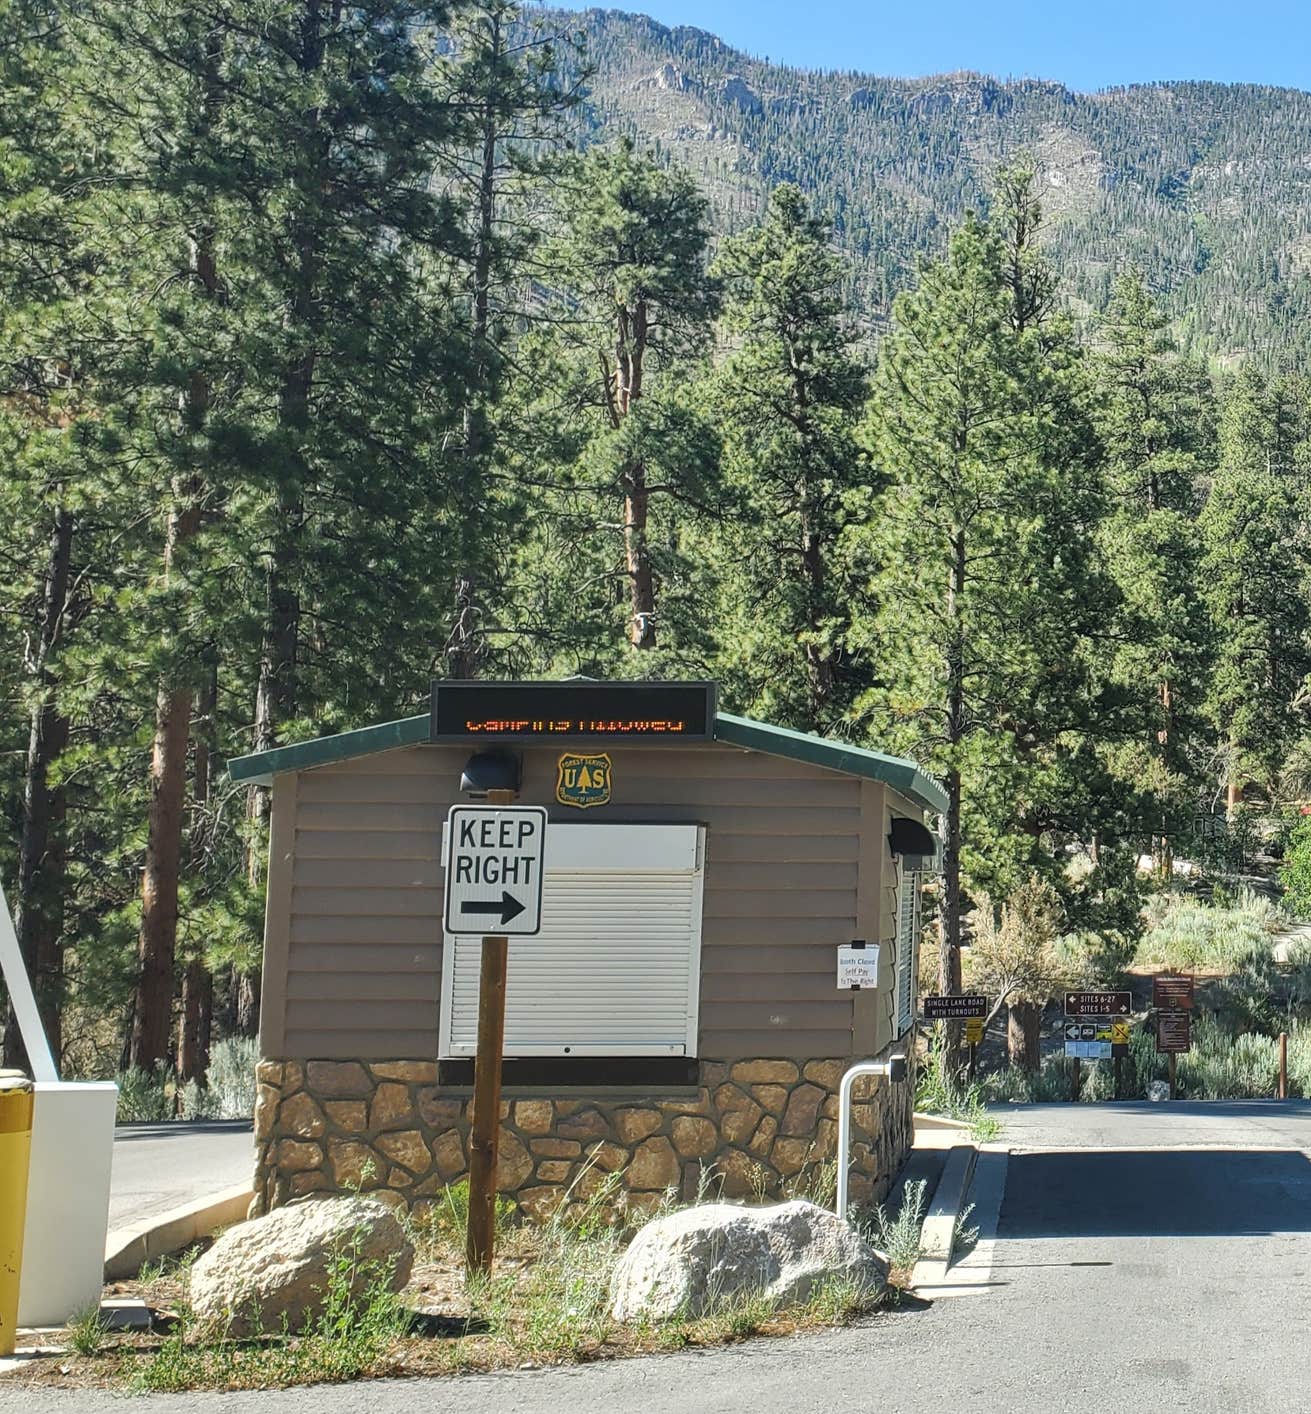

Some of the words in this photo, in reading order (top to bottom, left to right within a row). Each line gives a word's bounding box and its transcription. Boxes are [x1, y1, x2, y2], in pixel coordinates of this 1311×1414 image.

[564, 768, 576, 788] U
[593, 769, 605, 788] S
[460, 819, 535, 848] KEEP
[455, 855, 536, 885] RIGHT
[927, 999, 949, 1007] SINGLE
[968, 998, 985, 1006] ROAD
[1080, 995, 1099, 1003] SITES
[1100, 995, 1116, 1003] 6-27
